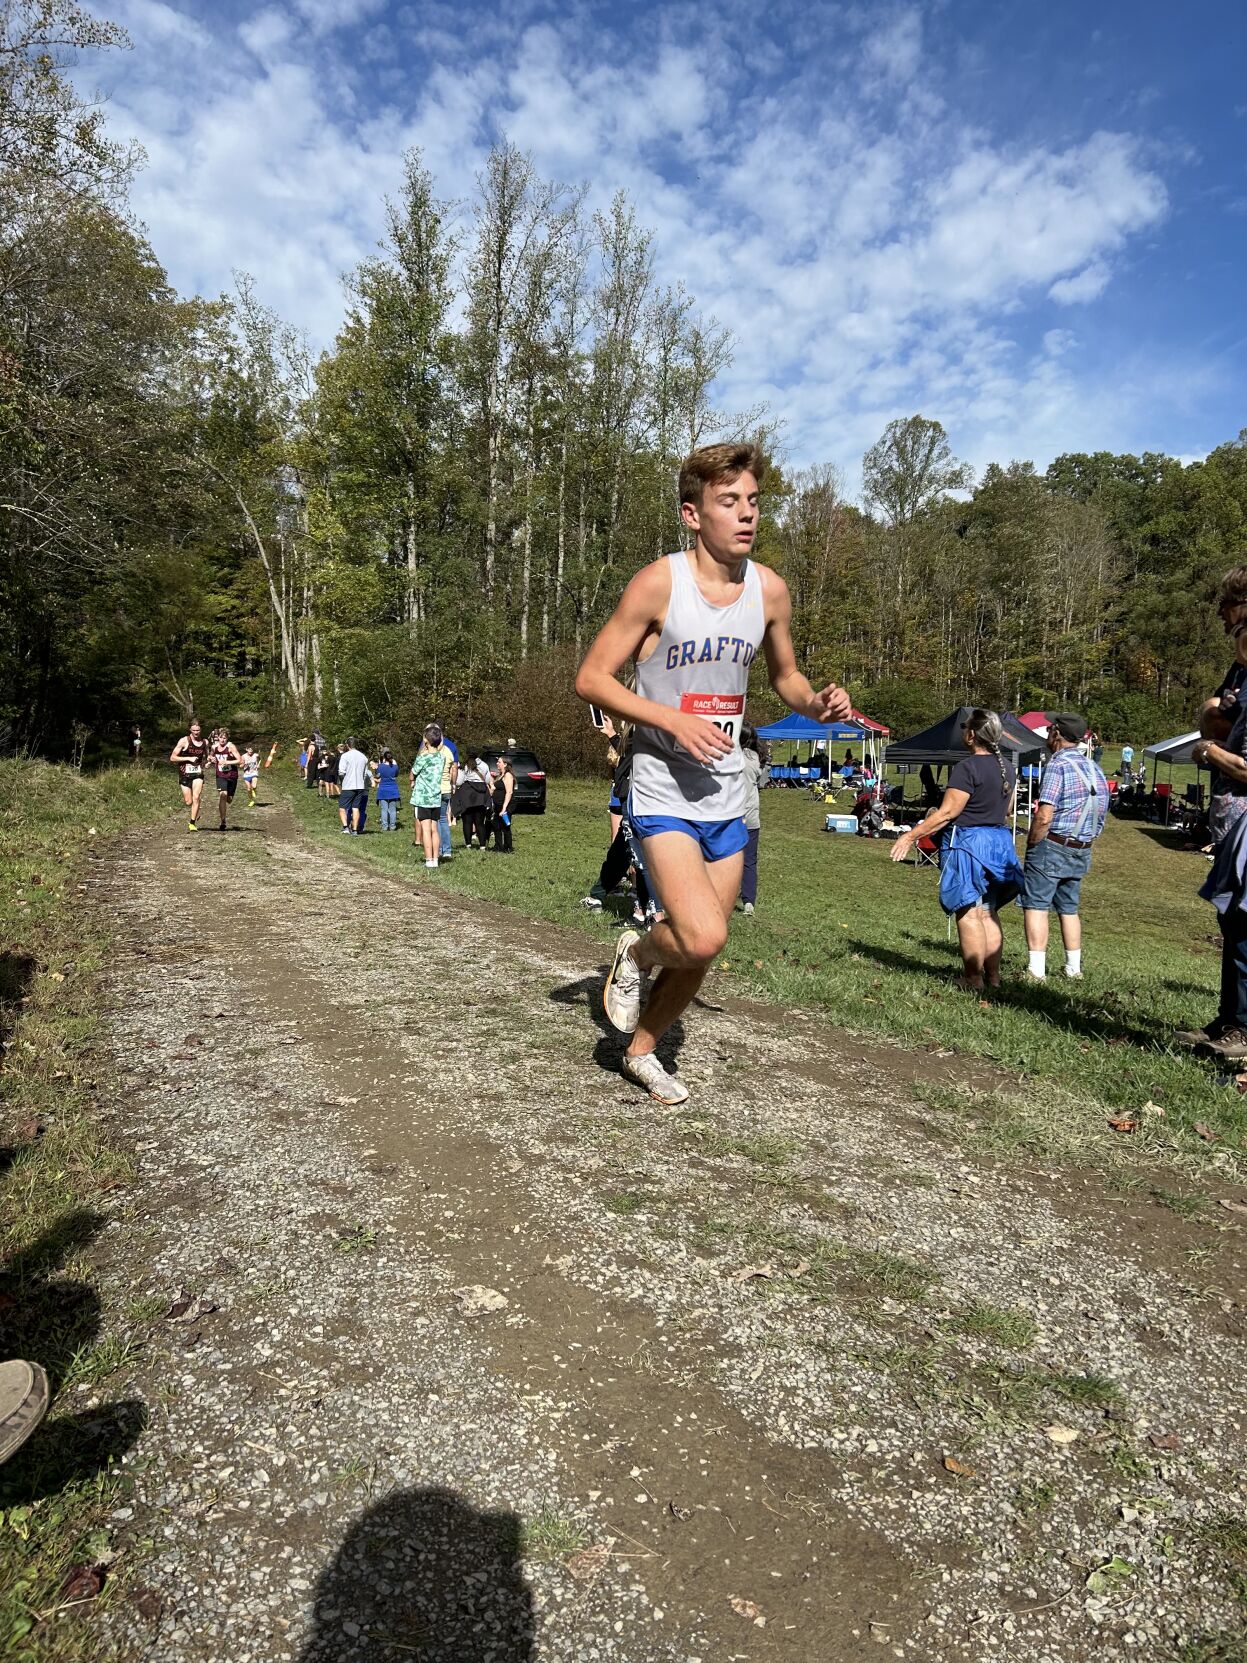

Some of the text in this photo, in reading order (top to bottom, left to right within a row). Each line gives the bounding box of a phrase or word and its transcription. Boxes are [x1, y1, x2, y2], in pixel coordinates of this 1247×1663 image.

[666, 636, 756, 670] GRAFTO
[693, 700, 739, 710] RACE RESULT
